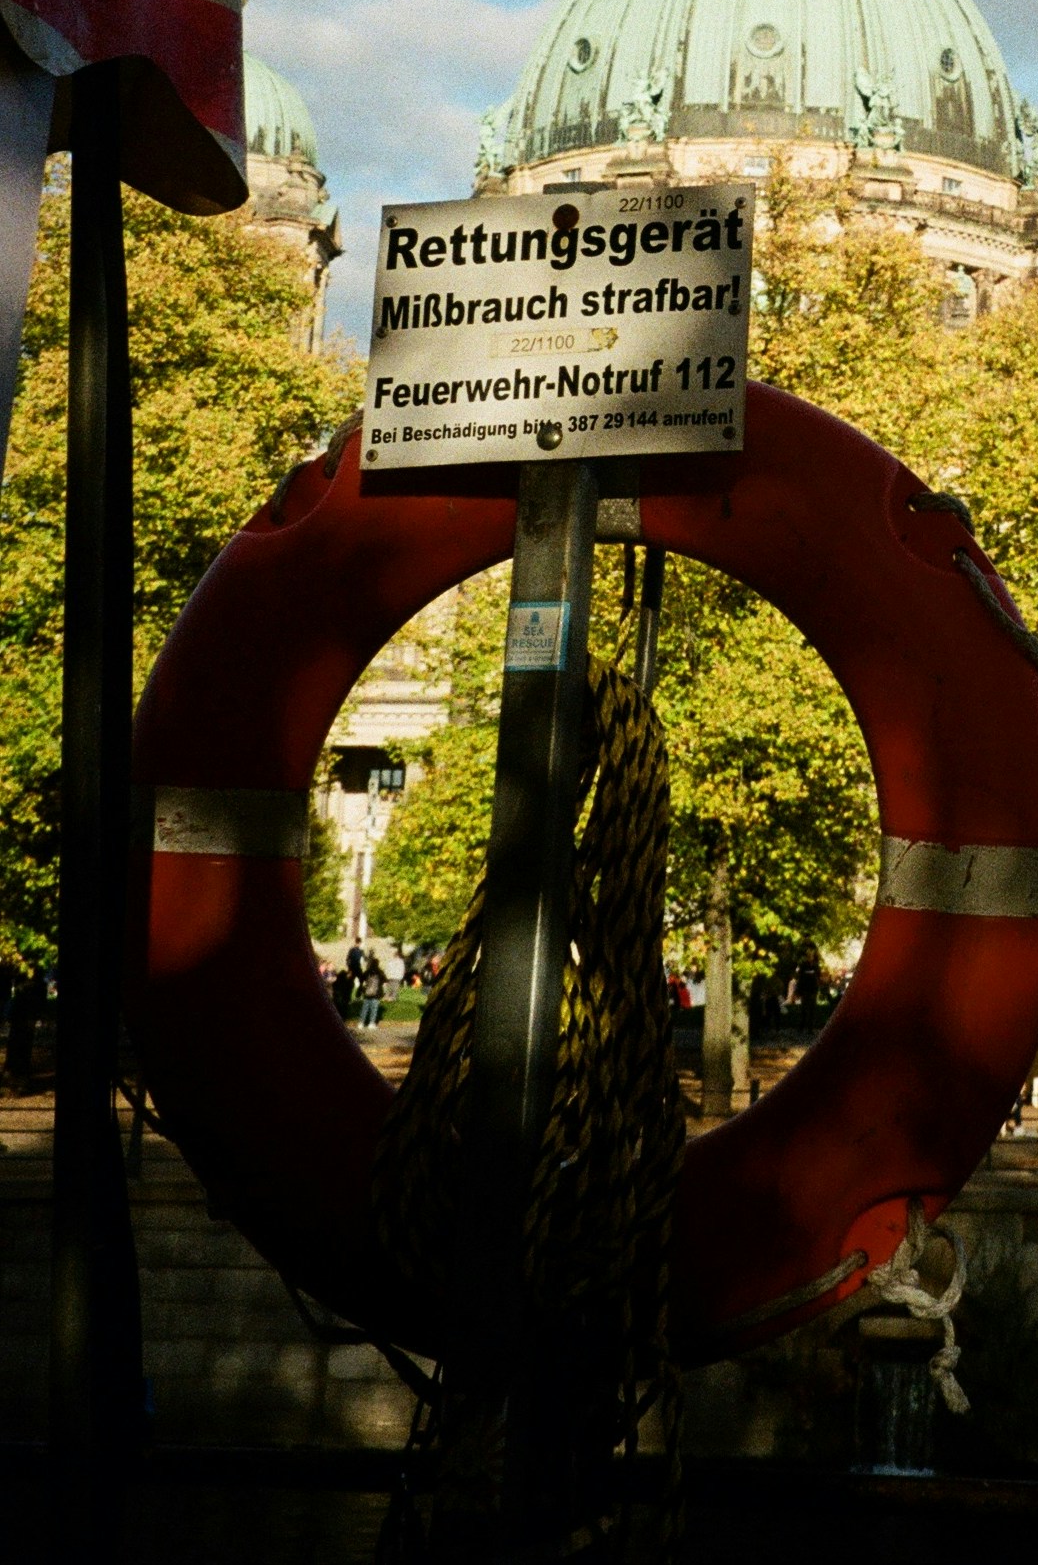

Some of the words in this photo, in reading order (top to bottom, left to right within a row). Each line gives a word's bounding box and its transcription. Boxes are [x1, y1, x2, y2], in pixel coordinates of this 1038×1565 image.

[618, 194, 685, 213] 22/1100
[385, 208, 743, 270] Rettungsgerät
[380, 285, 568, 331] Mißbrauch
[580, 275, 741, 316] strafbar!
[510, 334, 576, 353] 22/1100
[374, 360, 664, 409] Feuerwehr-Notruf
[675, 355, 736, 391] 112
[371, 426, 397, 444] Bei
[402, 422, 517, 441] Beschädigung
[567, 414, 599, 432] 387
[662, 408, 734, 426] anrufen!
[511, 637, 553, 648] RESCUE
[523, 625, 545, 635] SEA
